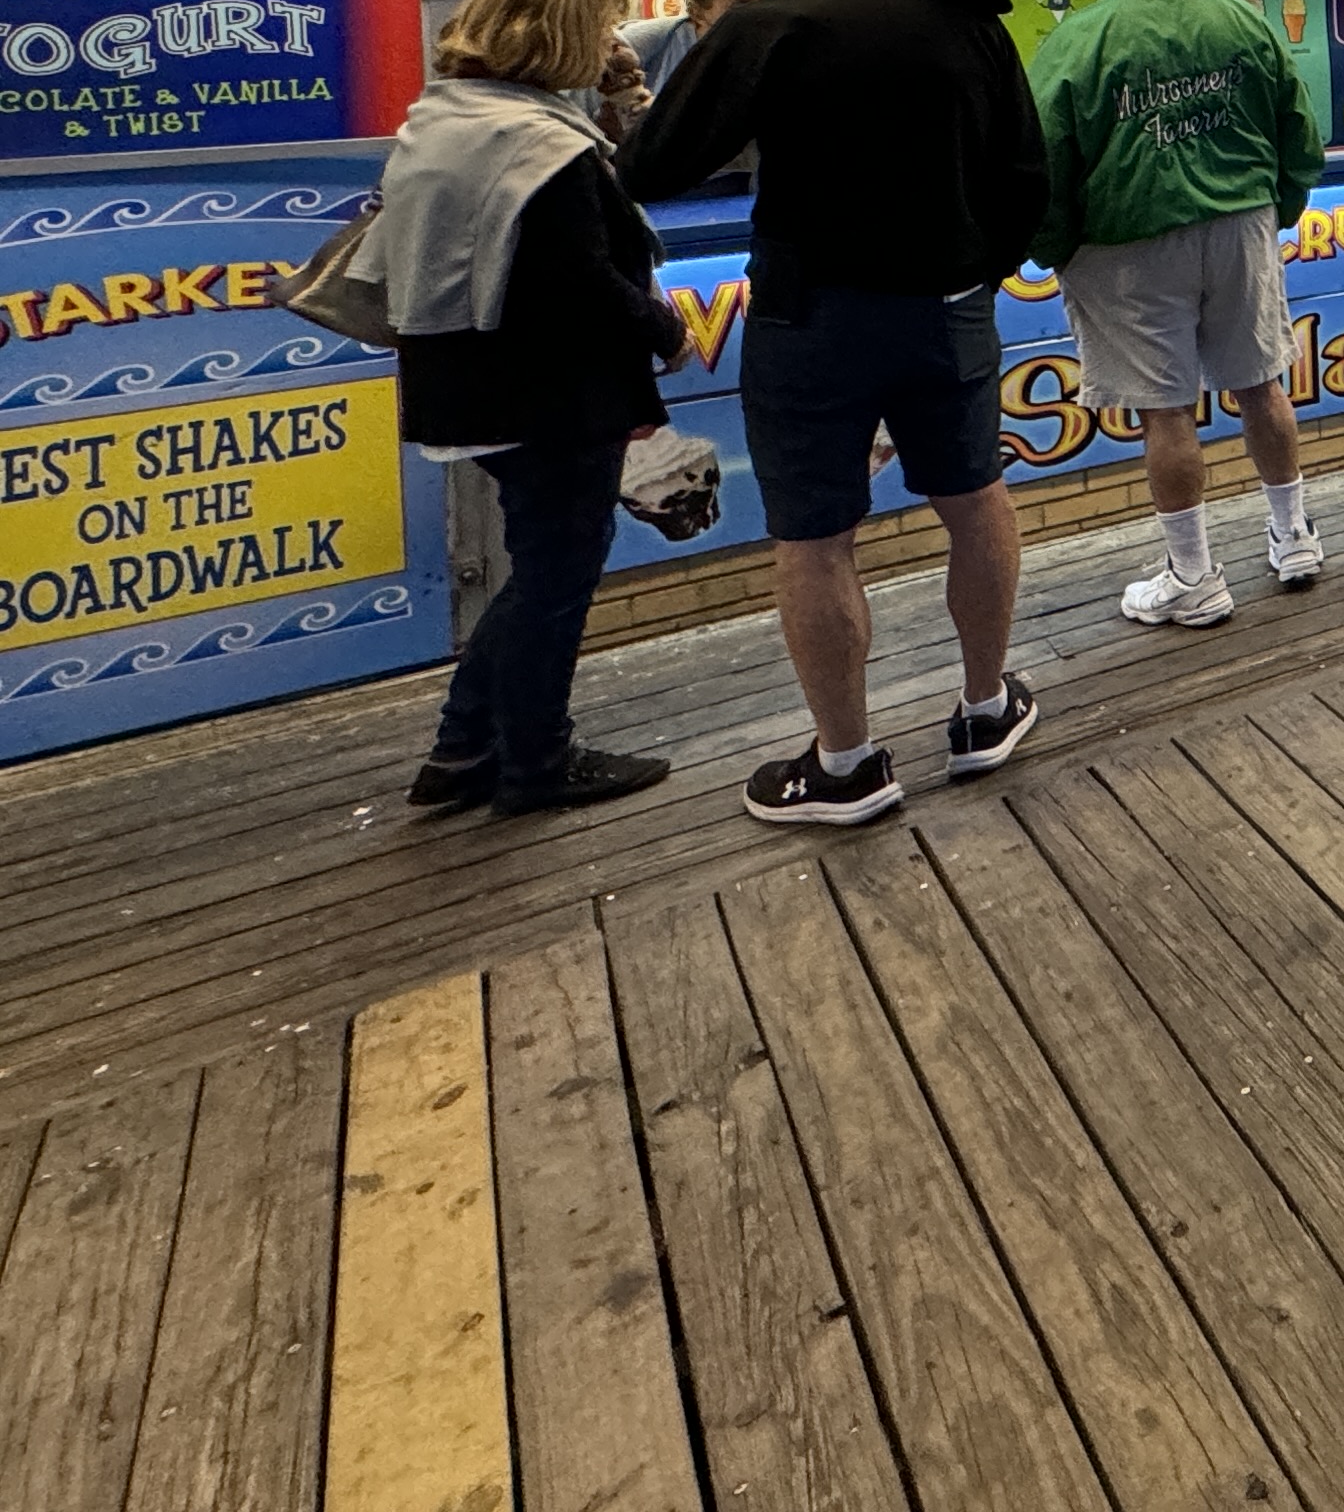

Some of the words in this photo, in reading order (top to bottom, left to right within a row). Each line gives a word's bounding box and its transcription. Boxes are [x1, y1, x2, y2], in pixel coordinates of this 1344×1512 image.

[0, 0, 325, 78] OGURT
[0, 85, 142, 113] COLATE
[156, 88, 181, 105] &
[194, 77, 333, 105] VANILLA
[64, 119, 90, 137] &
[103, 111, 206, 138] TWIST
[1145, 106, 1231, 151] Tavern
[0, 261, 303, 341] TARKE
[0, 435, 116, 504] EST
[136, 399, 349, 481] SHAKES
[79, 496, 147, 544] ON
[163, 479, 254, 531] THE
